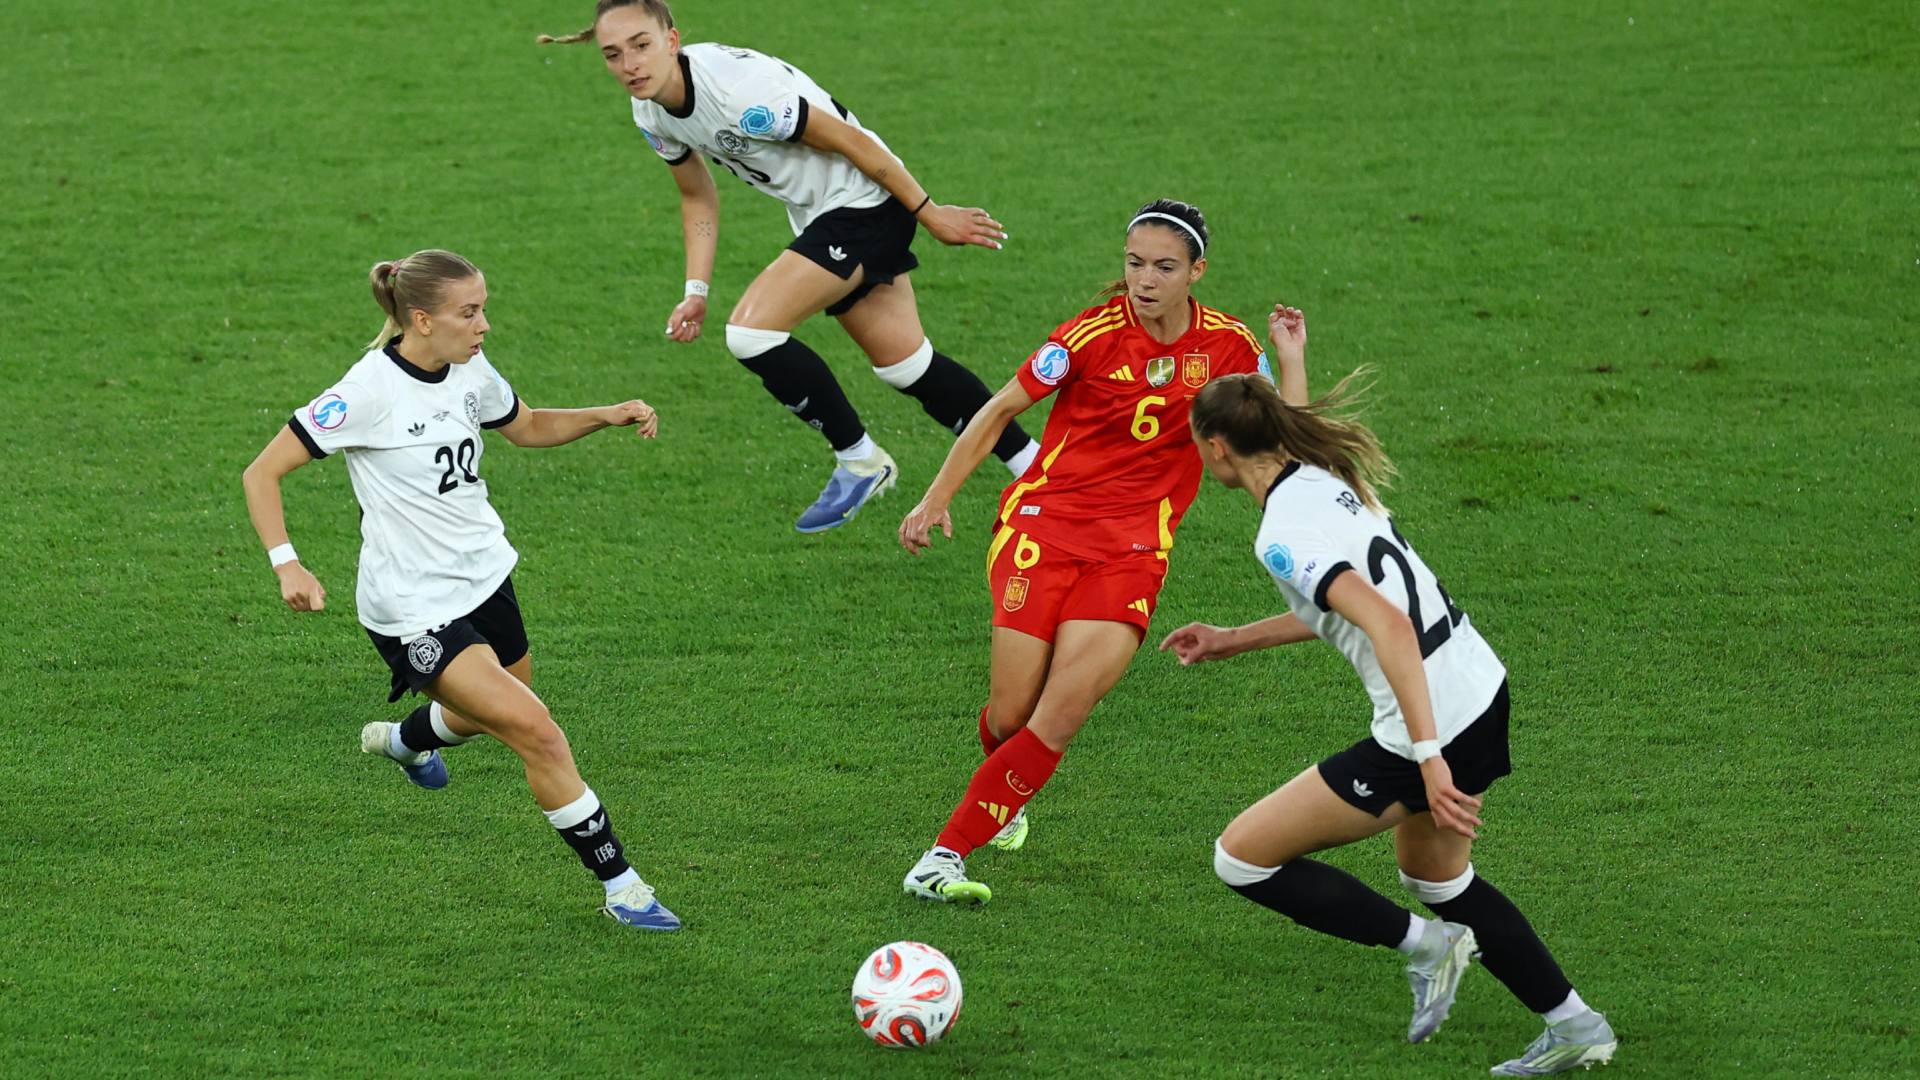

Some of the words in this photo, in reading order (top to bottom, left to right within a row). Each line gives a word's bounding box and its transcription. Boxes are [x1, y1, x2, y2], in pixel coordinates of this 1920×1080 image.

[1130, 396, 1166, 441] 6
[434, 438, 478, 495] 20
[1336, 490, 1362, 515] BR
[1013, 533, 1040, 569] 6
